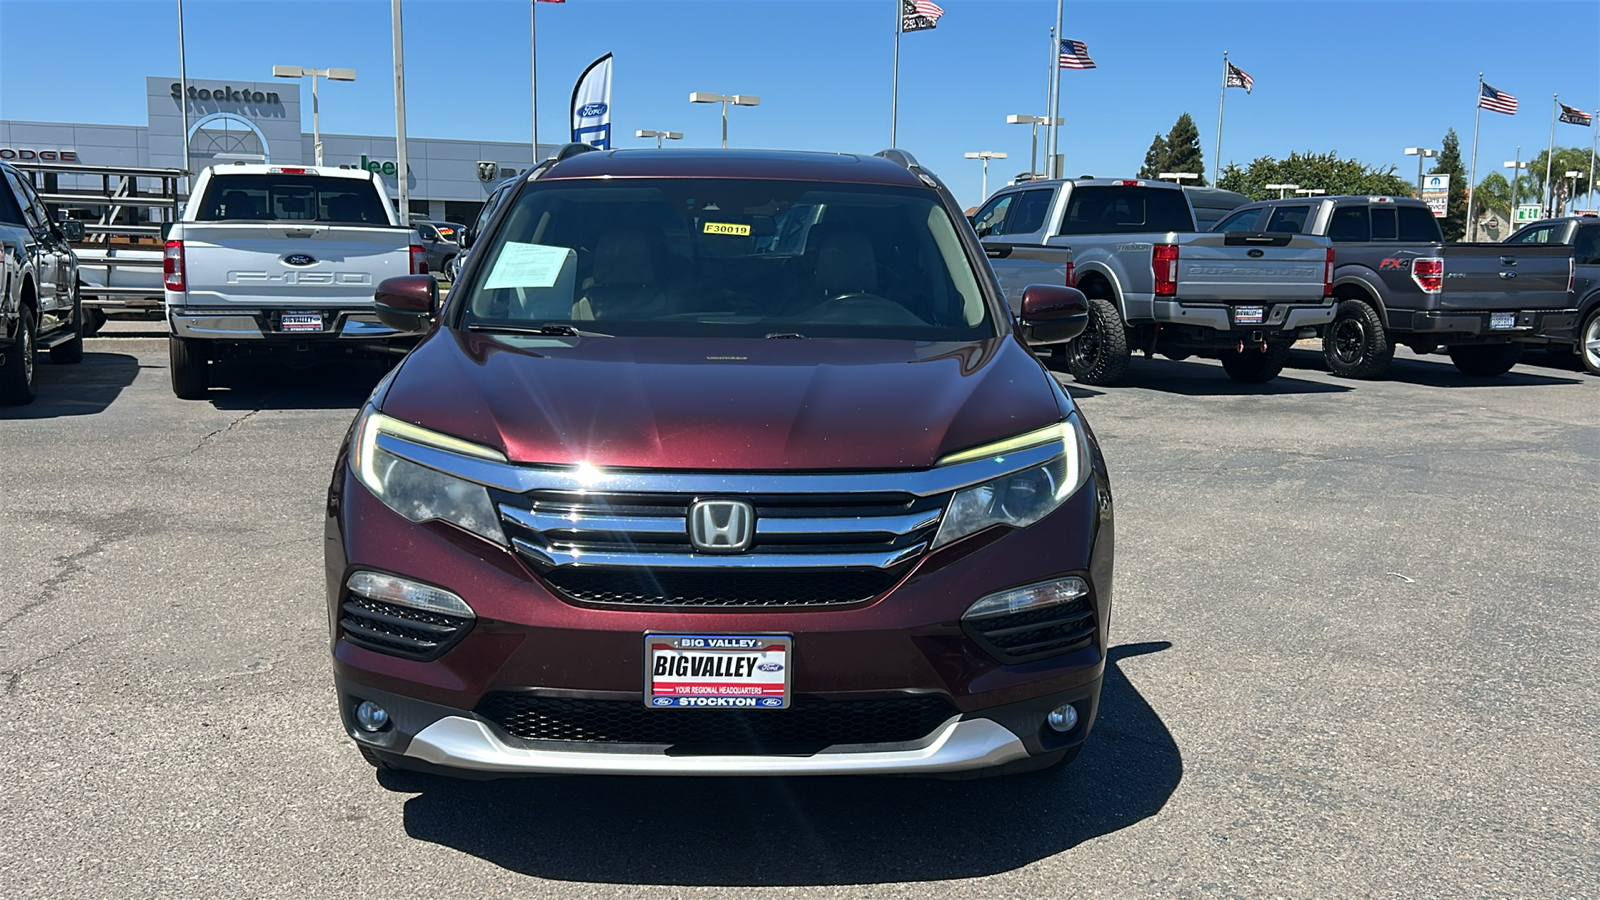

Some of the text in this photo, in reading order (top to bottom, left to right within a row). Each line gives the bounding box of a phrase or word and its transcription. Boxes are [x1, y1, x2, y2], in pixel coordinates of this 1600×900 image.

[170, 82, 280, 104] Stockton
[582, 104, 605, 116] Ford
[706, 225, 747, 234] F30019
[1380, 258, 1410, 268] FX4
[226, 270, 373, 285] F-150
[681, 638, 756, 647] BIG VALLEY
[653, 655, 758, 677] BIGVALLEY
[675, 686, 763, 694] YOUR REGIONAL HEADQUARTERS
[679, 697, 756, 706] STOCKTON
